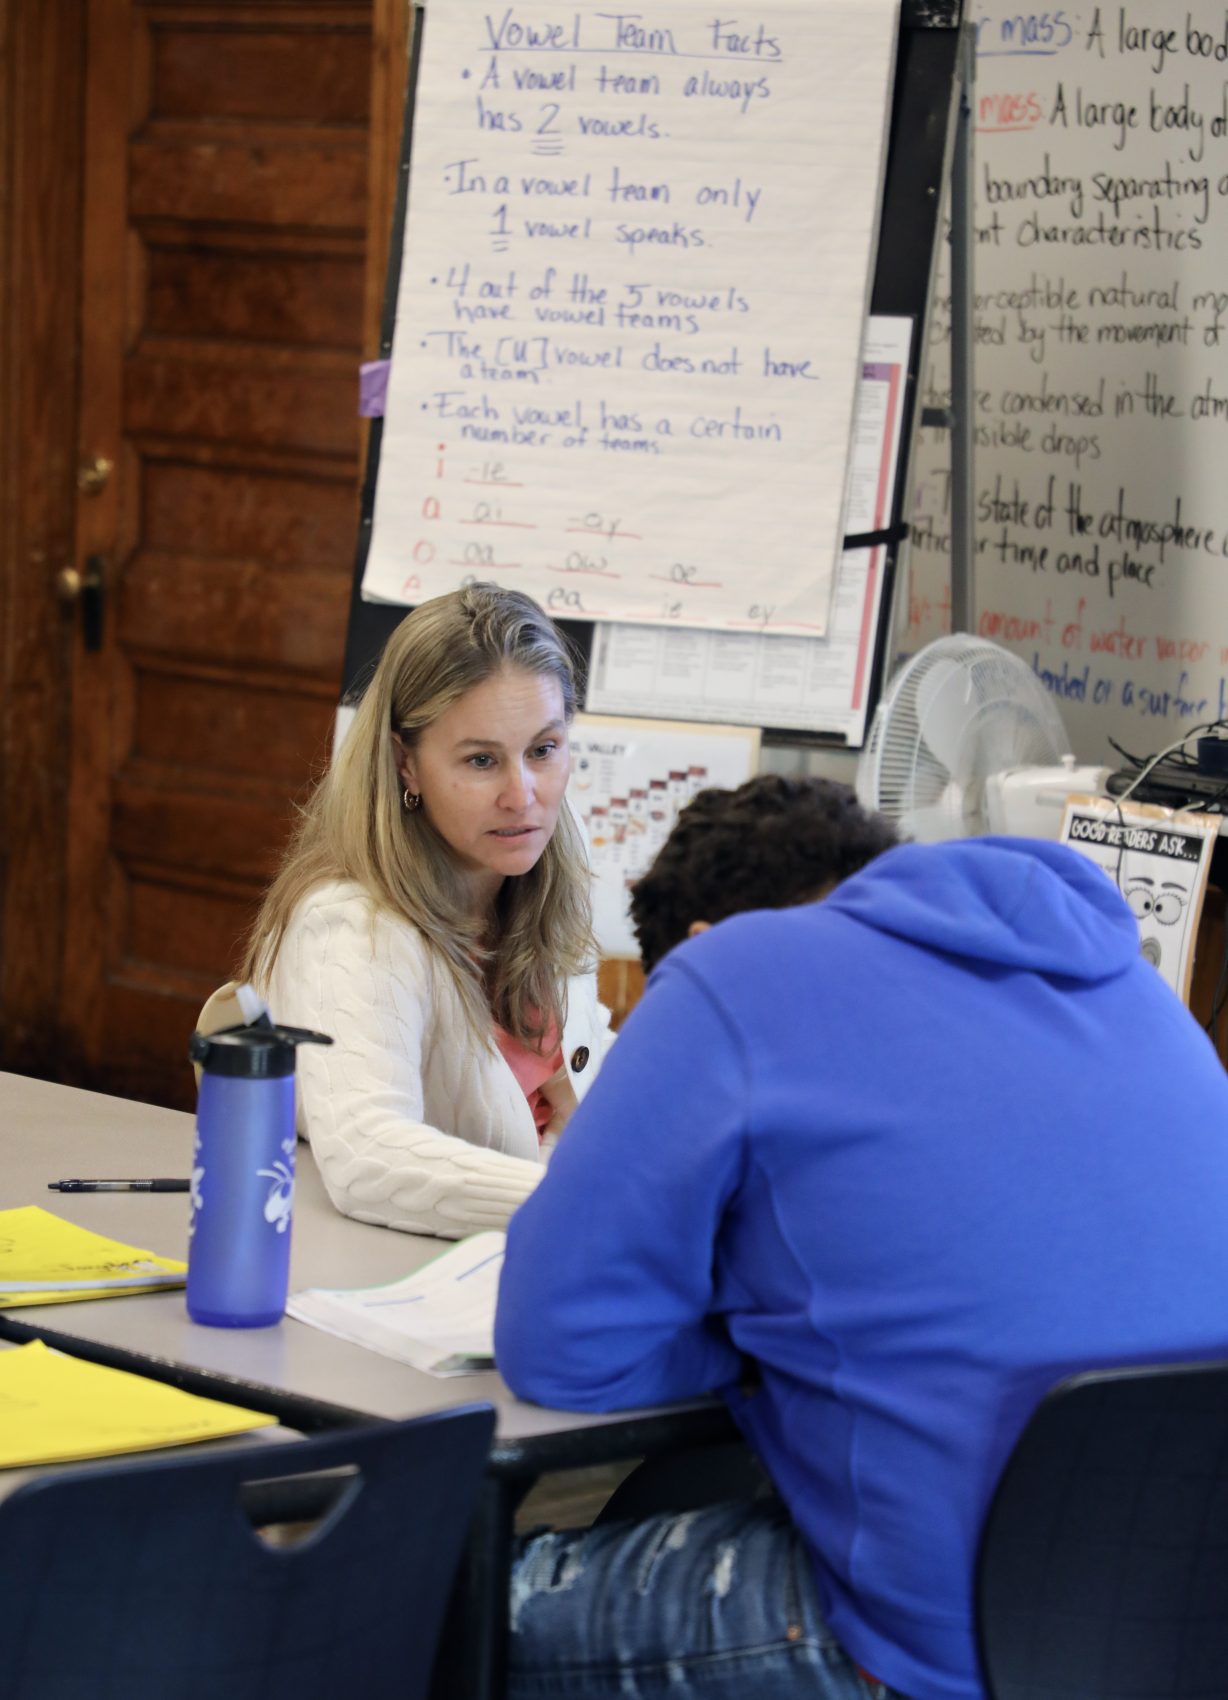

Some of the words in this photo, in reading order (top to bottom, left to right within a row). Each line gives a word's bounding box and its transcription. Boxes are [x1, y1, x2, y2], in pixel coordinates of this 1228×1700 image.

[484, 8, 581, 50] Vowel
[595, 13, 680, 54] Team
[705, 19, 783, 57] Facts
[1086, 7, 1105, 58] A
[1119, 7, 1179, 74] large
[479, 56, 500, 90] A
[513, 65, 576, 91] vowel
[595, 66, 660, 94] team
[683, 66, 771, 113] always
[477, 95, 523, 133] has
[535, 103, 562, 136] 2
[1050, 82, 1068, 128] A
[1076, 87, 1138, 151] large
[1150, 83, 1203, 162] body
[493, 174, 511, 194] a
[522, 173, 591, 197] vowel
[608, 166, 670, 204] team
[695, 178, 762, 222] only
[1092, 160, 1209, 224] separating
[490, 204, 512, 235] 1
[524, 217, 591, 240] vowel
[1017, 205, 1202, 250] characteristics
[446, 263, 470, 297] 4
[479, 271, 518, 299] out
[529, 267, 557, 300] of
[568, 273, 608, 305] the
[624, 284, 652, 309] 5
[657, 287, 750, 312] vowels
[974, 271, 1081, 314] erceptible
[1089, 270, 1179, 312] natural
[453, 299, 516, 324] have
[535, 305, 605, 327] vowel
[615, 303, 699, 334] teams
[1018, 314, 1045, 364] by
[1050, 313, 1089, 344] the
[1204, 313, 1225, 347] of
[426, 331, 481, 360] The
[555, 346, 623, 368] vowel
[642, 342, 695, 373] does
[702, 347, 743, 375] not
[763, 346, 819, 380] have
[431, 392, 500, 420] Each
[600, 400, 643, 432] has
[655, 418, 673, 436] a
[690, 406, 781, 441] certain
[1000, 371, 1104, 417] condensed
[1115, 379, 1134, 418] in
[1135, 371, 1185, 419] the
[460, 424, 551, 446] number
[563, 427, 588, 447] of
[1042, 423, 1101, 468] drops
[436, 442, 446, 479] i
[978, 474, 1028, 527] state
[1034, 474, 1056, 528] of
[1099, 487, 1217, 563] atmosphere
[1056, 544, 1100, 577] and
[1071, 818, 1106, 842] GOOD
